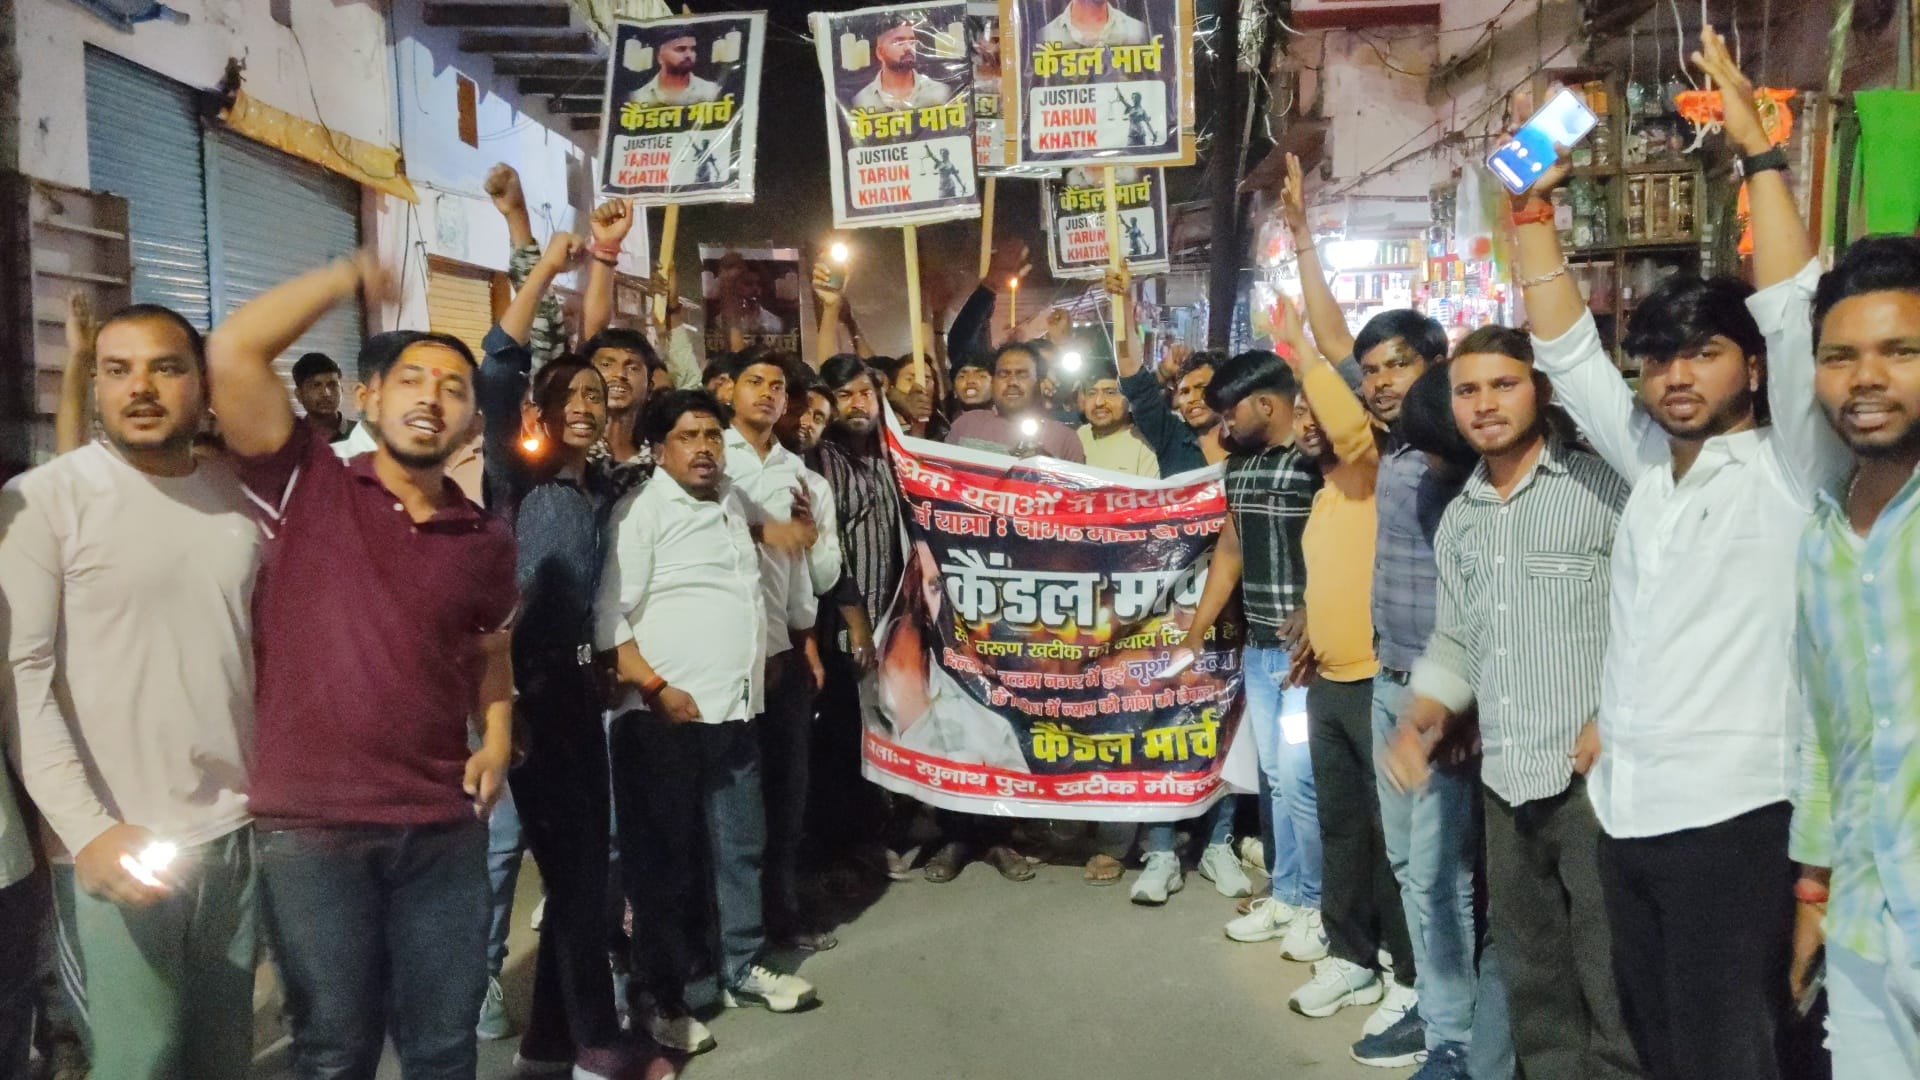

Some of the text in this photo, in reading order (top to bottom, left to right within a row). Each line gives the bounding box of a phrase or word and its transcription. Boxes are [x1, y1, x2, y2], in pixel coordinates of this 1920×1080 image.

[1032, 35, 1164, 78] कैंडल मार्च
[1040, 88, 1097, 106] JUSTICE
[620, 93, 734, 130] कैंडल मार्च
[850, 107, 914, 139] कैंडल
[918, 93, 967, 131] मार्च
[1041, 108, 1097, 127] TARUN
[623, 136, 673, 150] JUSTICE
[1039, 130, 1098, 150] KHATIK
[624, 152, 671, 167] TARUN
[856, 147, 909, 165] JUSTICE
[858, 165, 909, 185] TARUN
[858, 185, 912, 206] KHATIK
[1067, 230, 1106, 245] TARUN
[1067, 243, 1110, 260] KHATIK
[934, 510, 991, 536] यात्रा
[941, 549, 1101, 627] कैंडल
[1027, 639, 1084, 660] खटीक
[1115, 632, 1157, 650] न्याय
[1044, 673, 1085, 689] नगर
[1029, 708, 1220, 765] कैंडल मार्च
[915, 759, 988, 786] रघुनाथ
[1054, 774, 1139, 796] खटीक
